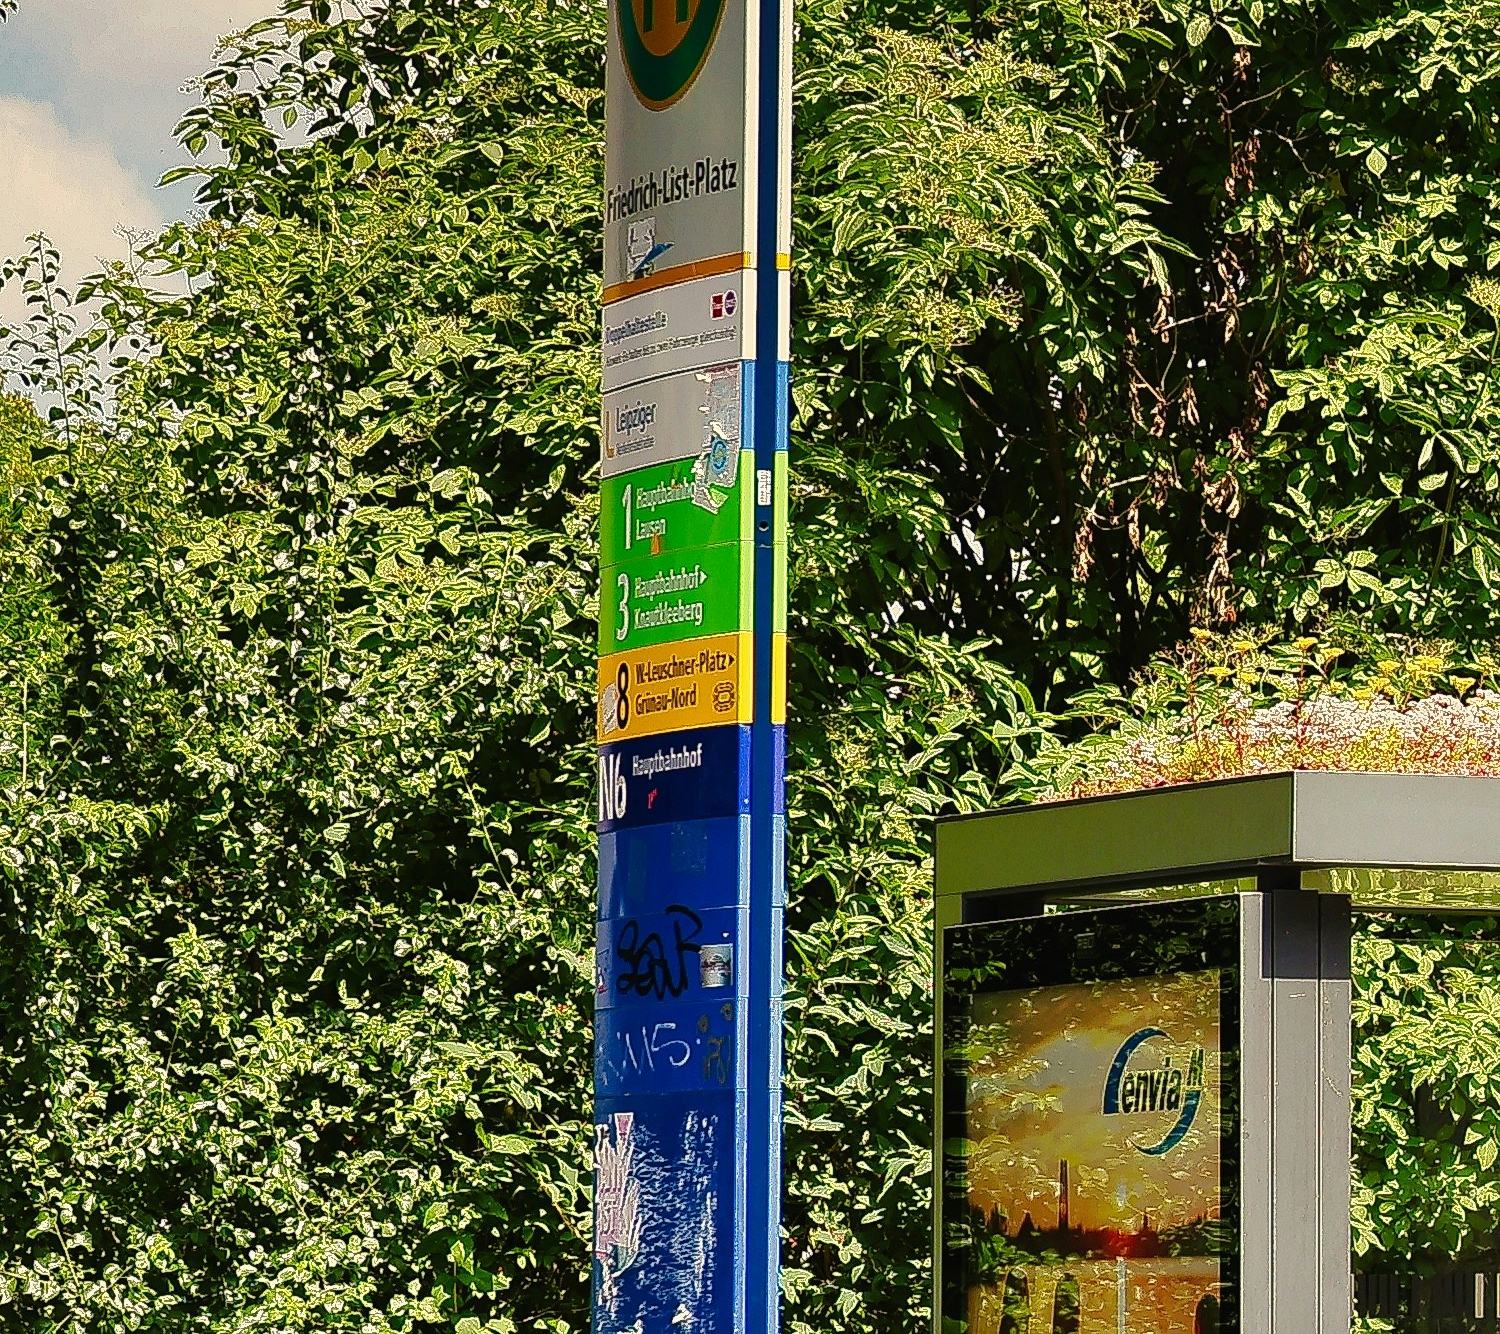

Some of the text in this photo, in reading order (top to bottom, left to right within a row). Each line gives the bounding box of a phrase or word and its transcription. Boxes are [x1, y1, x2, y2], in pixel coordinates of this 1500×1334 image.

[606, 155, 738, 224] Friedrich-List-Platz
[616, 400, 656, 436] Leipziger
[621, 477, 695, 550] 1 Hauptbahnho
[636, 519, 666, 541] Lausen
[615, 564, 700, 641] 3 Hauptbahnhof
[634, 598, 703, 630] Knautkleeberg
[617, 662, 629, 730] 8
[635, 683, 697, 715] Grünau-Nord
[599, 742, 703, 822] N6 Hauptbahnhof
